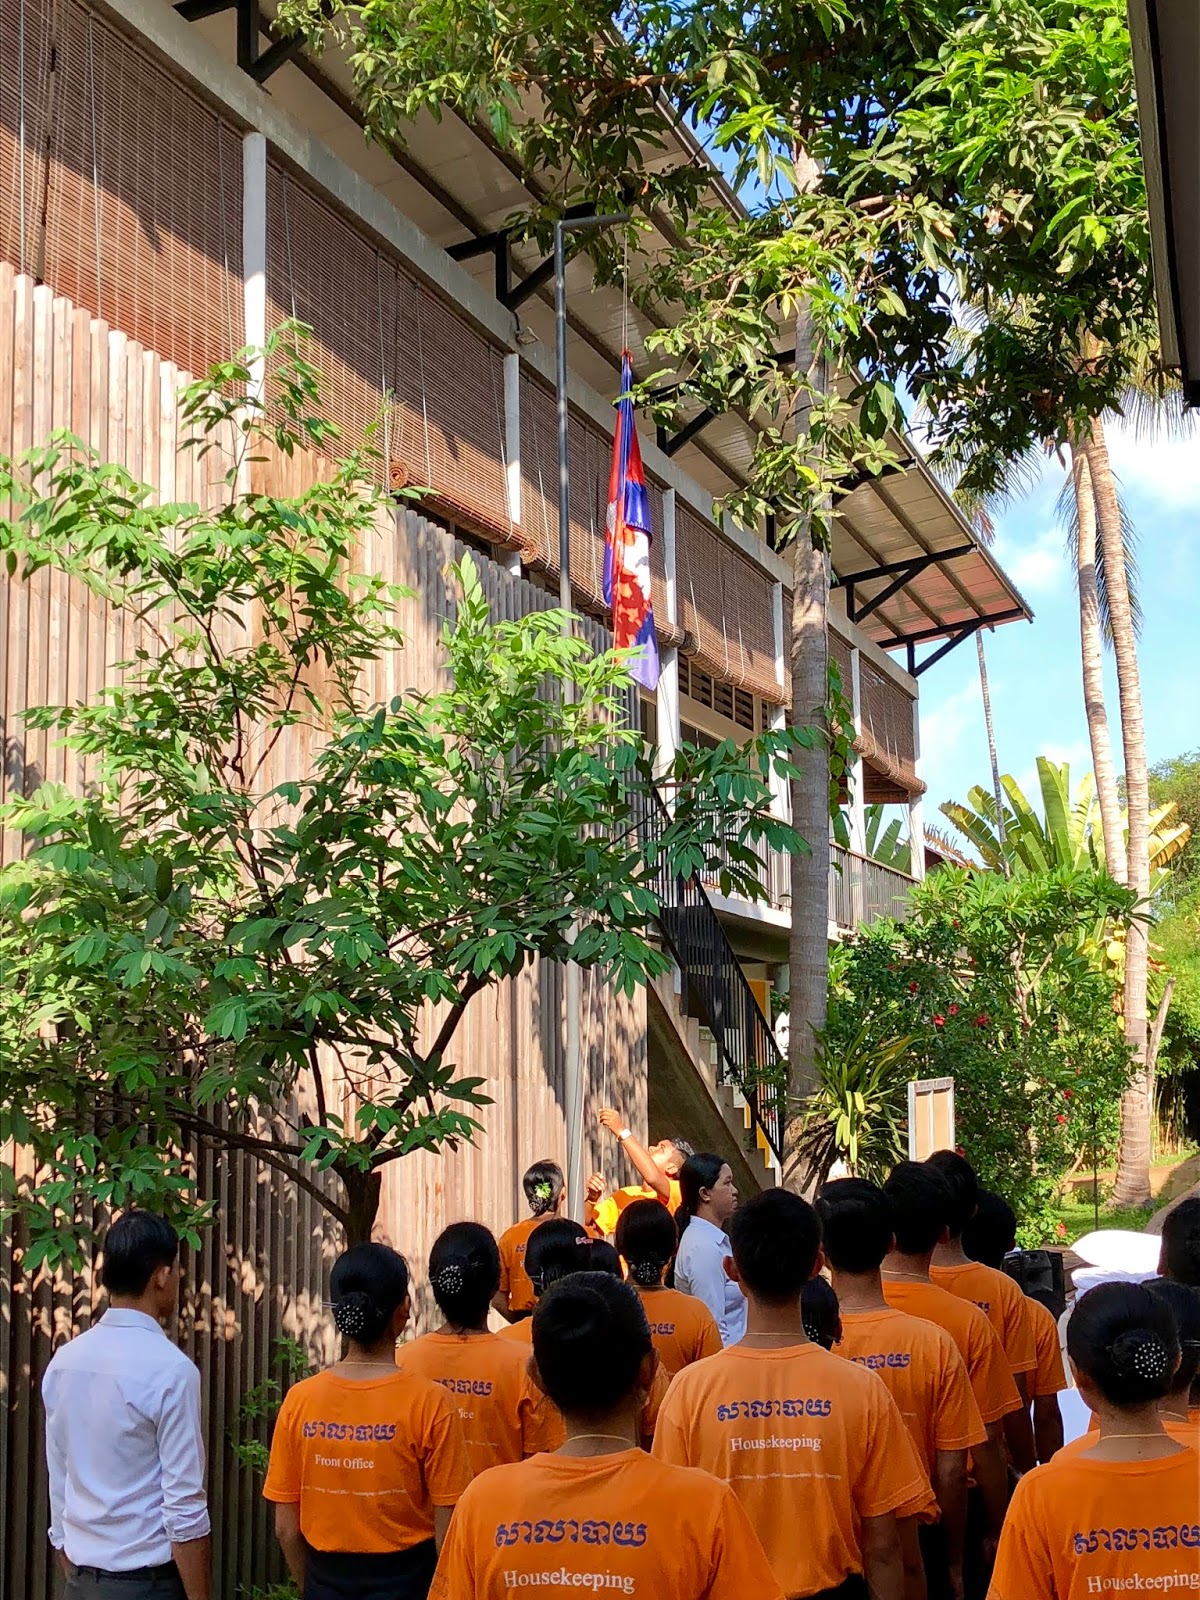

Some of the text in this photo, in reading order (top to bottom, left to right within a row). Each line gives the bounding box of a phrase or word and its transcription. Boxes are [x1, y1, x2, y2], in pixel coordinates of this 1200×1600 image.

[730, 1434, 822, 1452] Housekeeping
[315, 1454, 375, 1469] Front Office
[503, 1566, 636, 1595] Housekeeping
[1086, 1568, 1200, 1594] Housekeeping
